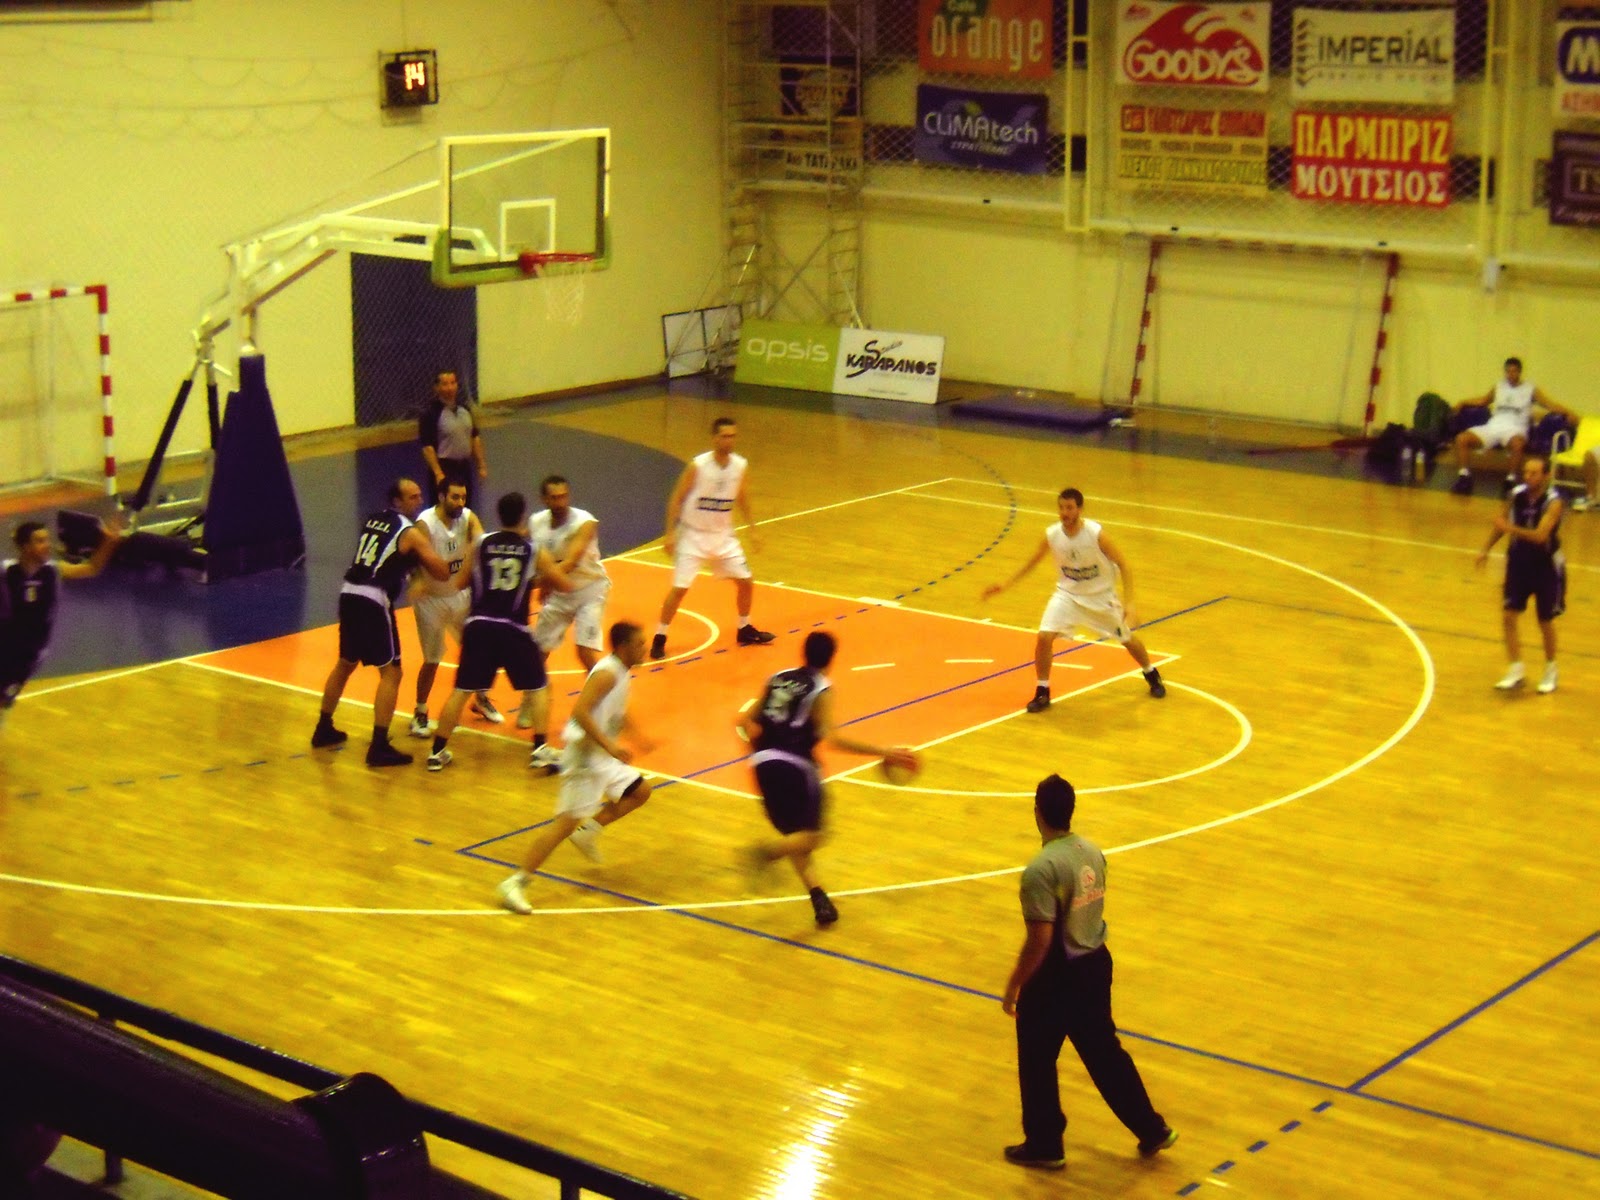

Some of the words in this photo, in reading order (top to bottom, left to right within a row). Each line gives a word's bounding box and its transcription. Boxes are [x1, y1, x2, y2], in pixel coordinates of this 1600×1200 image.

[931, 15, 1044, 72] orange
[404, 61, 426, 90] 14
[1295, 114, 1449, 164] ΠΑΡΜΠΡΙΖ
[1295, 164, 1446, 204] ΜΟΥΤΣΙΟΣ
[746, 338, 830, 363] opsis
[845, 353, 937, 376] KARAPANOS
[354, 532, 379, 567] 14
[487, 556, 523, 592] 13
